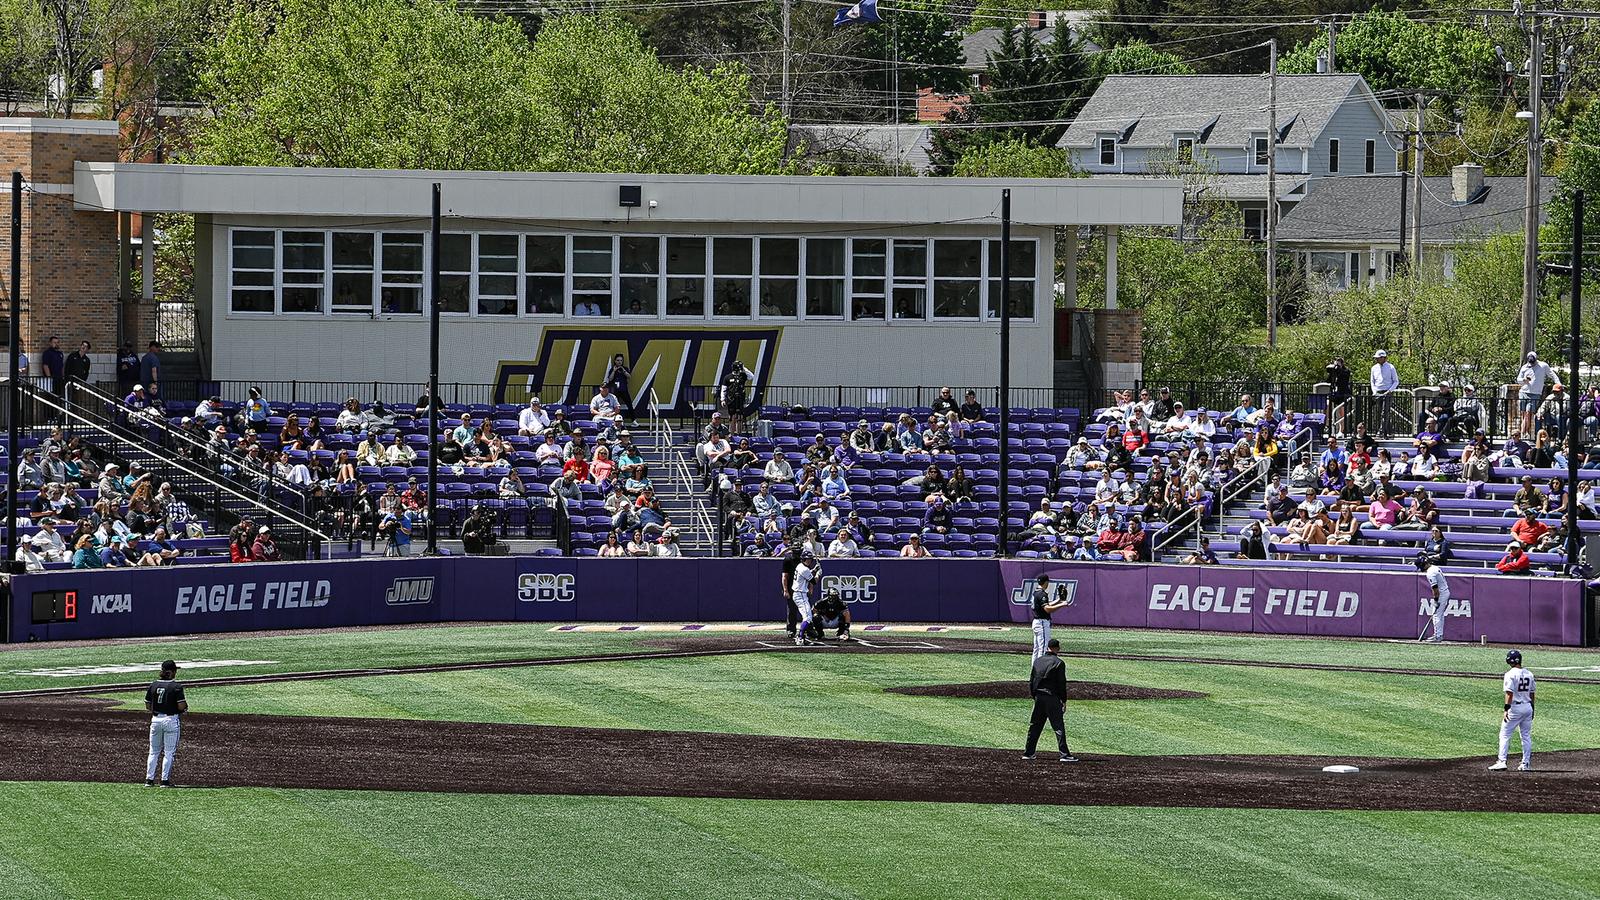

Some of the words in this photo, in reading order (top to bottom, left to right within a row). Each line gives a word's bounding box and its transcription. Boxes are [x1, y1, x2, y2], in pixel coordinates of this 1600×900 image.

[494, 327, 783, 421] JMU
[175, 582, 256, 614] EAGLE
[262, 580, 331, 609] FIELD
[386, 576, 435, 605] JMU
[518, 573, 575, 602] SBC
[821, 575, 877, 603] SBC
[1149, 584, 1255, 614] EAGLE
[1264, 588, 1359, 618] FIELD
[65, 591, 76, 619] 8
[91, 593, 132, 614] NCAA
[1419, 598, 1472, 618] NAA
[156, 687, 166, 704] 7
[1517, 677, 1530, 692] 22
